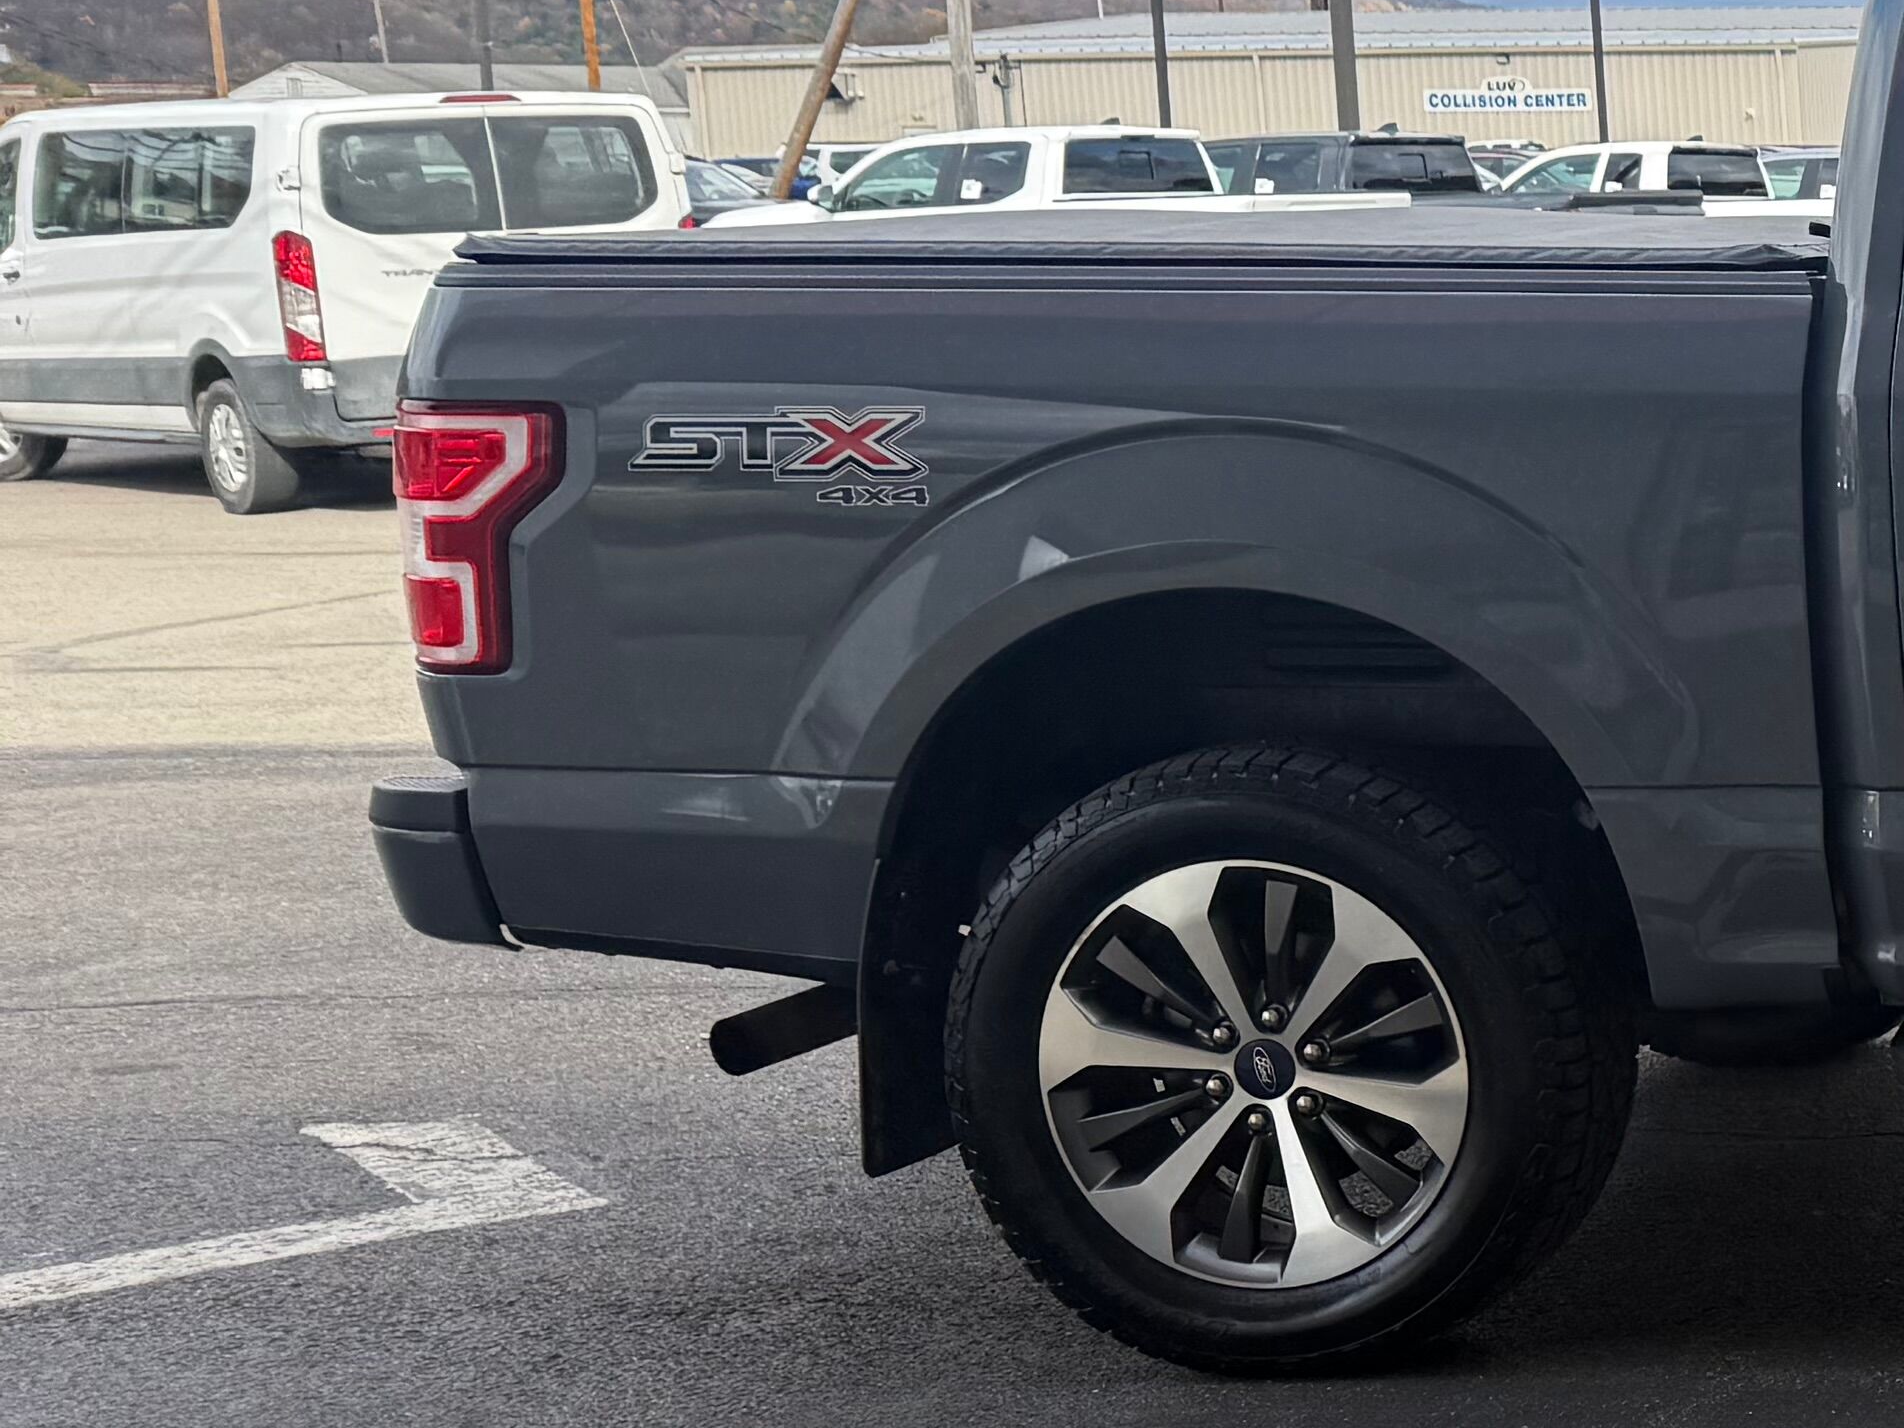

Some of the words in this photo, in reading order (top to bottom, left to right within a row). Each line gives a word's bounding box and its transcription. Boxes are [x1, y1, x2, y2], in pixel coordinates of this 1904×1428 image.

[1487, 81, 1517, 91] LUV
[1429, 94, 1517, 108] COLLISION
[1524, 93, 1587, 107] CENTER
[628, 406, 929, 482] STX
